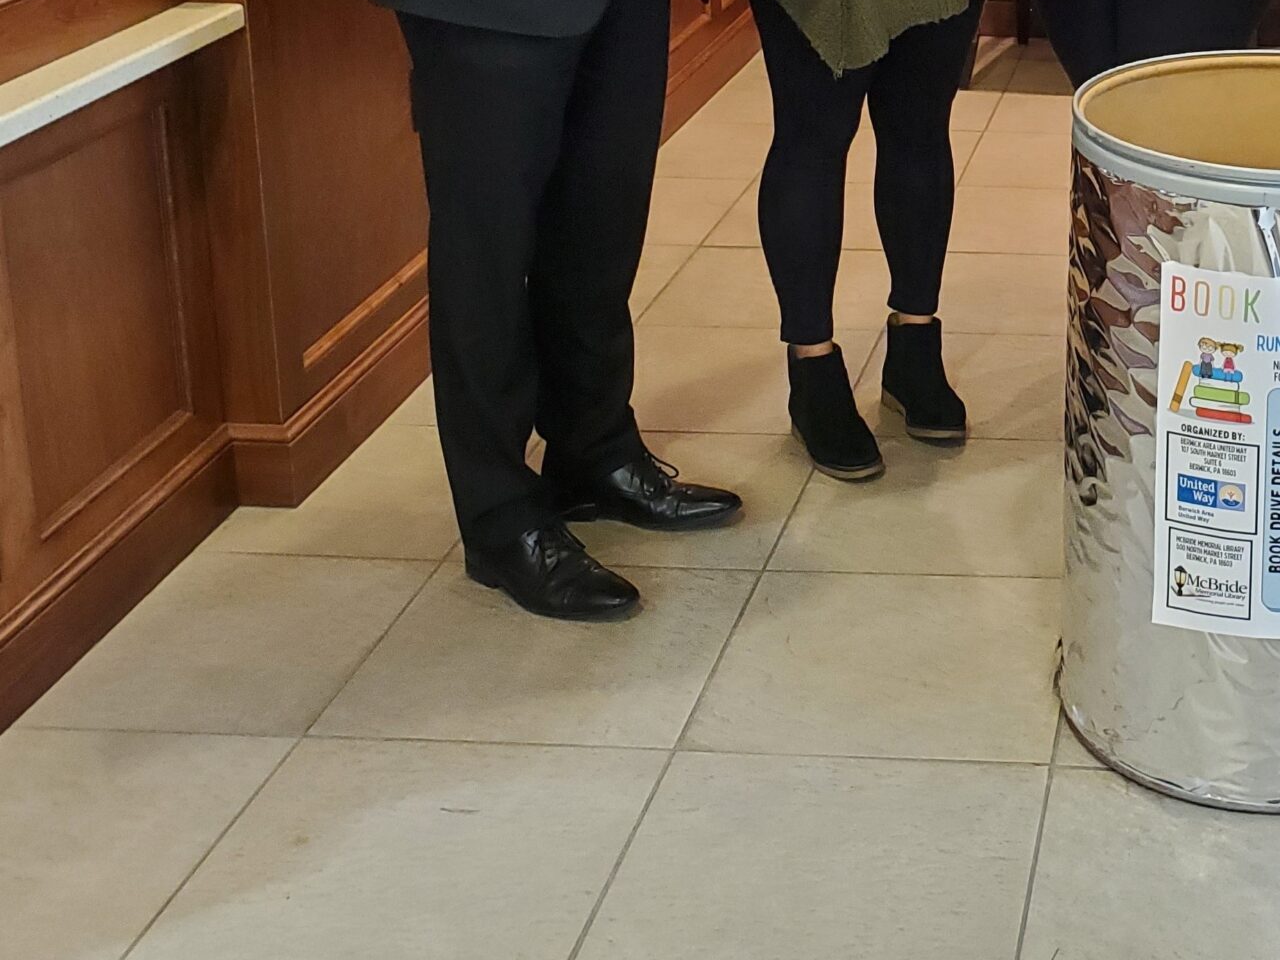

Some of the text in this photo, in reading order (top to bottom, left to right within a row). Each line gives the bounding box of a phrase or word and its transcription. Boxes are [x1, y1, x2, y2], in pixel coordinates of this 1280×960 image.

[1170, 275, 1261, 324] BOOK
[1181, 424, 1245, 441] ORGANIZED BY:
[1181, 438, 1201, 447] BERWICK
[1217, 445, 1235, 453] UNITED
[1207, 450, 1227, 460] MARKET
[1228, 454, 1246, 462] STREET
[1179, 477, 1215, 505] United Way
[1178, 505, 1214, 517] Berwick Area
[1186, 546, 1202, 554] NORTH
[1204, 549, 1222, 558] MARKET
[1224, 553, 1242, 561] STREET
[1187, 573, 1247, 594] McBride
[1224, 593, 1245, 601] Library
